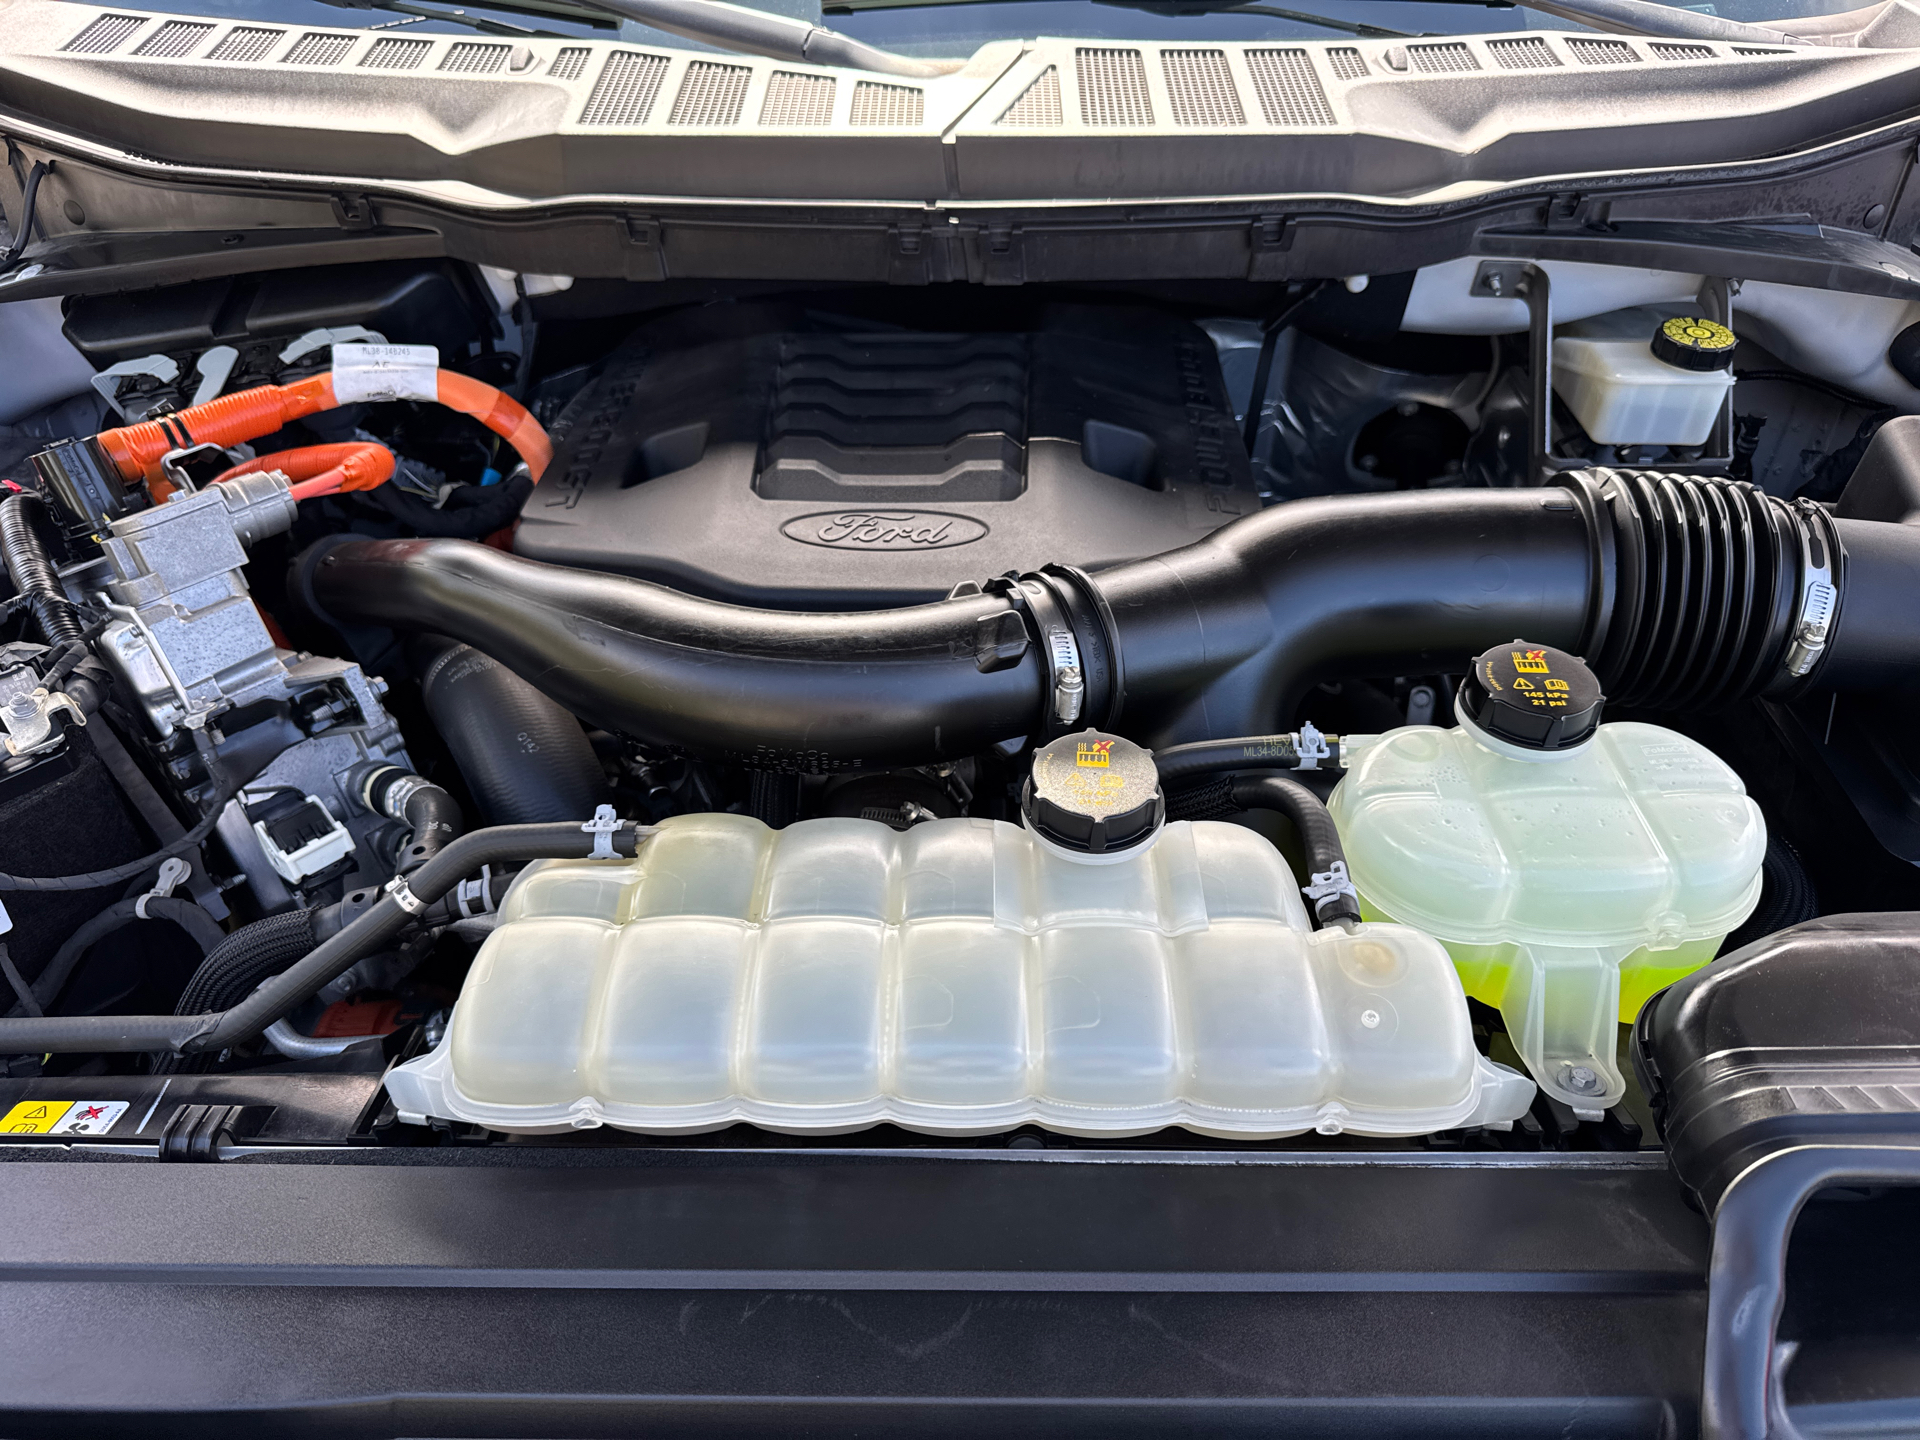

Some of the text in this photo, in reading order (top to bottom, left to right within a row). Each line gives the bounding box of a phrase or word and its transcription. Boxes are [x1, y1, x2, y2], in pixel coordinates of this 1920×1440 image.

[817, 514, 953, 544] Ford
[1546, 691, 1569, 699] kPa
[1549, 699, 1567, 707] psi
